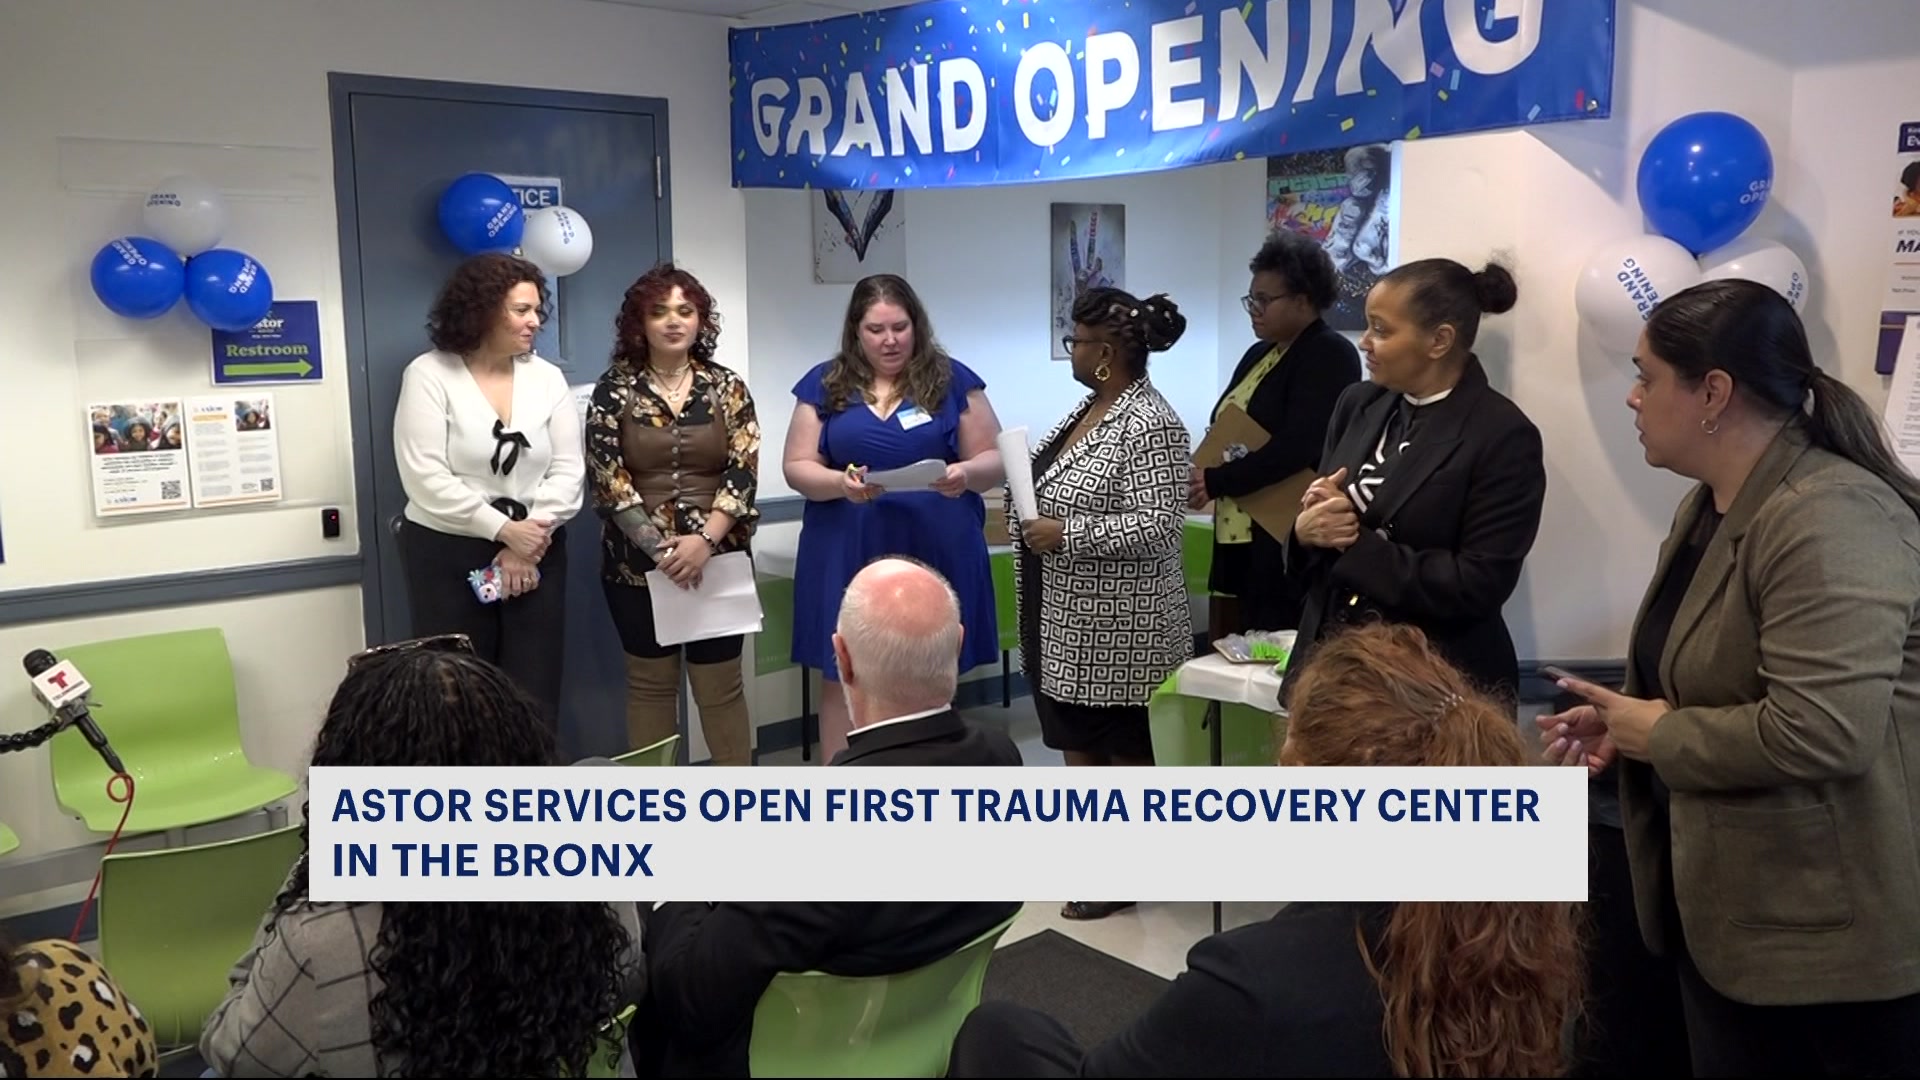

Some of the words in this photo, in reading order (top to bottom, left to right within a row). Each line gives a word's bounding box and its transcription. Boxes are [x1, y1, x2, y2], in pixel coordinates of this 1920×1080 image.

[751, 58, 988, 157] GRAND
[1014, 0, 1544, 147] OPENING
[513, 188, 551, 207] ICE
[486, 202, 512, 230] GRAND
[488, 204, 518, 238] OPENING
[226, 344, 309, 357] Restroom
